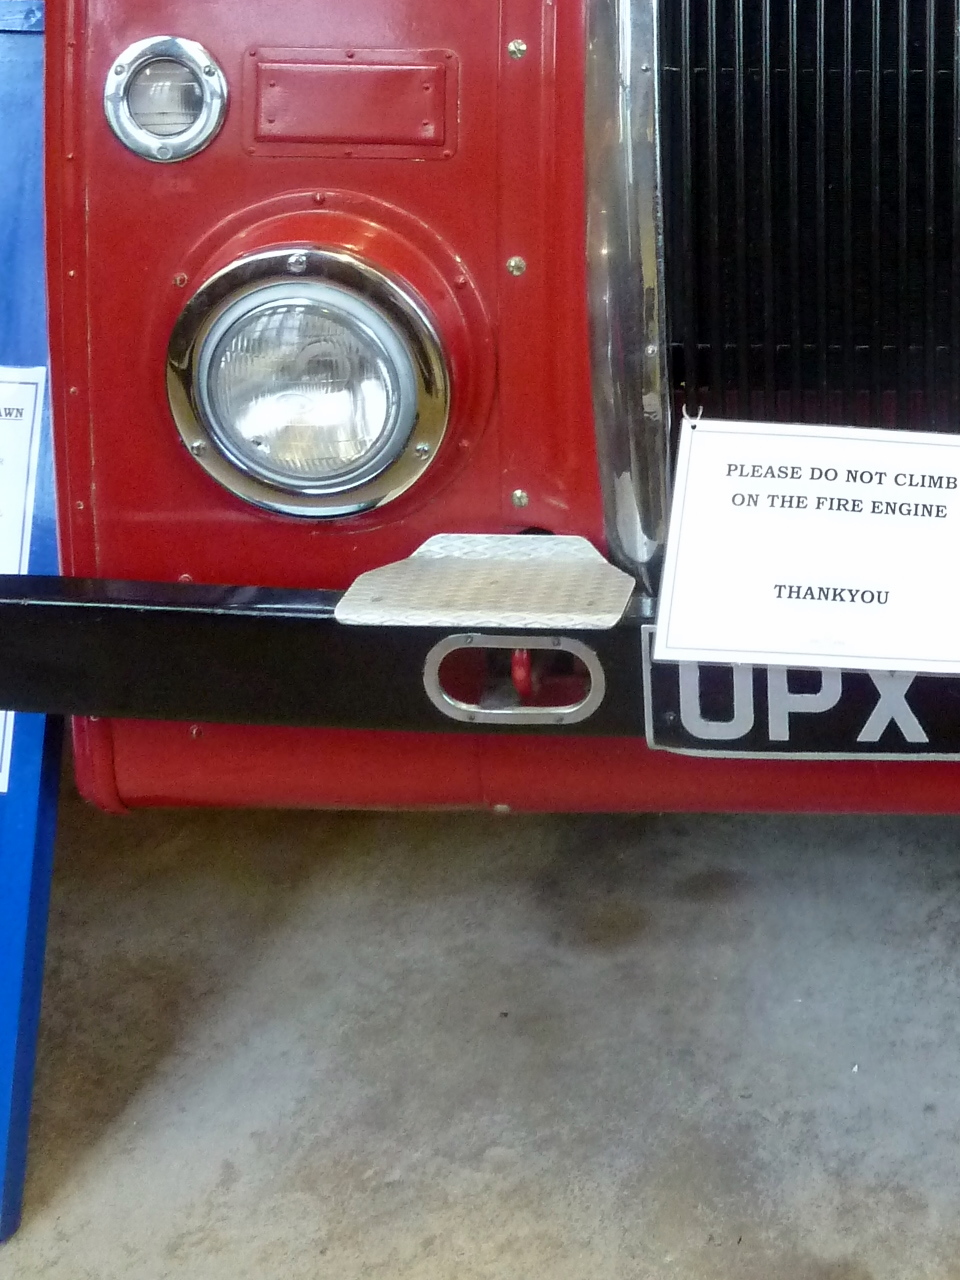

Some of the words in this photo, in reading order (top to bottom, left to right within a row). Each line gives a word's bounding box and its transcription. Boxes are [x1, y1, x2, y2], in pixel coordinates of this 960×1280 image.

[0, 407, 24, 419] WN
[725, 463, 803, 480] PLEASE
[809, 467, 839, 482] DO
[845, 469, 888, 486] NOT
[894, 473, 960, 491] CLIMB
[731, 493, 760, 508] ON
[766, 494, 809, 510] THE
[815, 497, 864, 514] FIRE
[870, 501, 949, 519] ENGINE
[774, 584, 891, 605] THANKYOU
[679, 660, 929, 742] UPX
